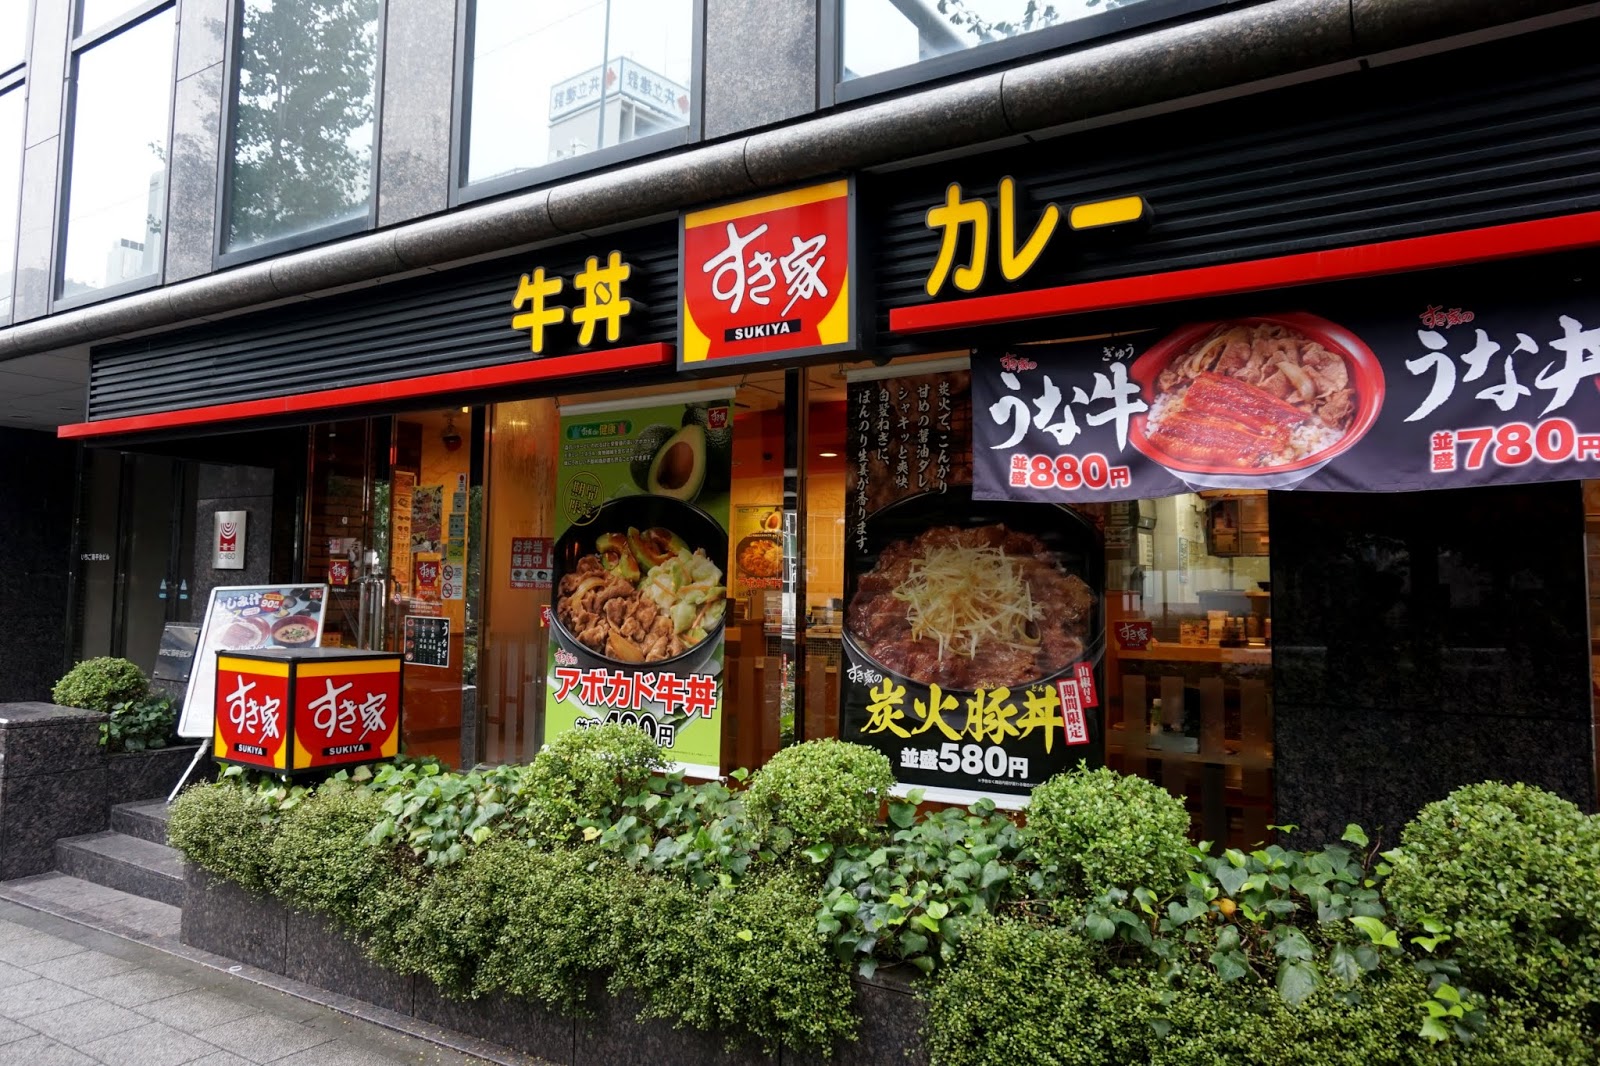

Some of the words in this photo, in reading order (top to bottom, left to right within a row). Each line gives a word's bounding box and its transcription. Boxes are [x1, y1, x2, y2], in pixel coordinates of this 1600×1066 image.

[925, 175, 1144, 297] カレー
[703, 221, 828, 316] すき家
[511, 250, 632, 355] 牛丼
[1419, 304, 1475, 328] すき家の
[734, 321, 792, 340] SUKIYA
[1000, 350, 1038, 373] すき家の
[1102, 343, 1135, 362] ぎゅう
[989, 361, 1149, 453] うな牛
[1431, 430, 1456, 472] 並盛
[1011, 454, 1028, 487] 並盛
[1030, 454, 1131, 489] 880円
[512, 554, 542, 568] 販売中
[513, 540, 543, 553] お弁当
[1119, 622, 1149, 643] すき家
[846, 662, 883, 687] すき家の
[226, 674, 281, 744] すき家
[308, 678, 388, 742] すき家
[554, 667, 718, 719] アボカド牛丼
[1062, 683, 1083, 739] 期間限定
[860, 677, 1065, 754] 炭火豚丼
[238, 743, 263, 756] SUKIYA
[329, 744, 365, 756] SUKIYA
[900, 742, 1029, 780] 並盛580円
